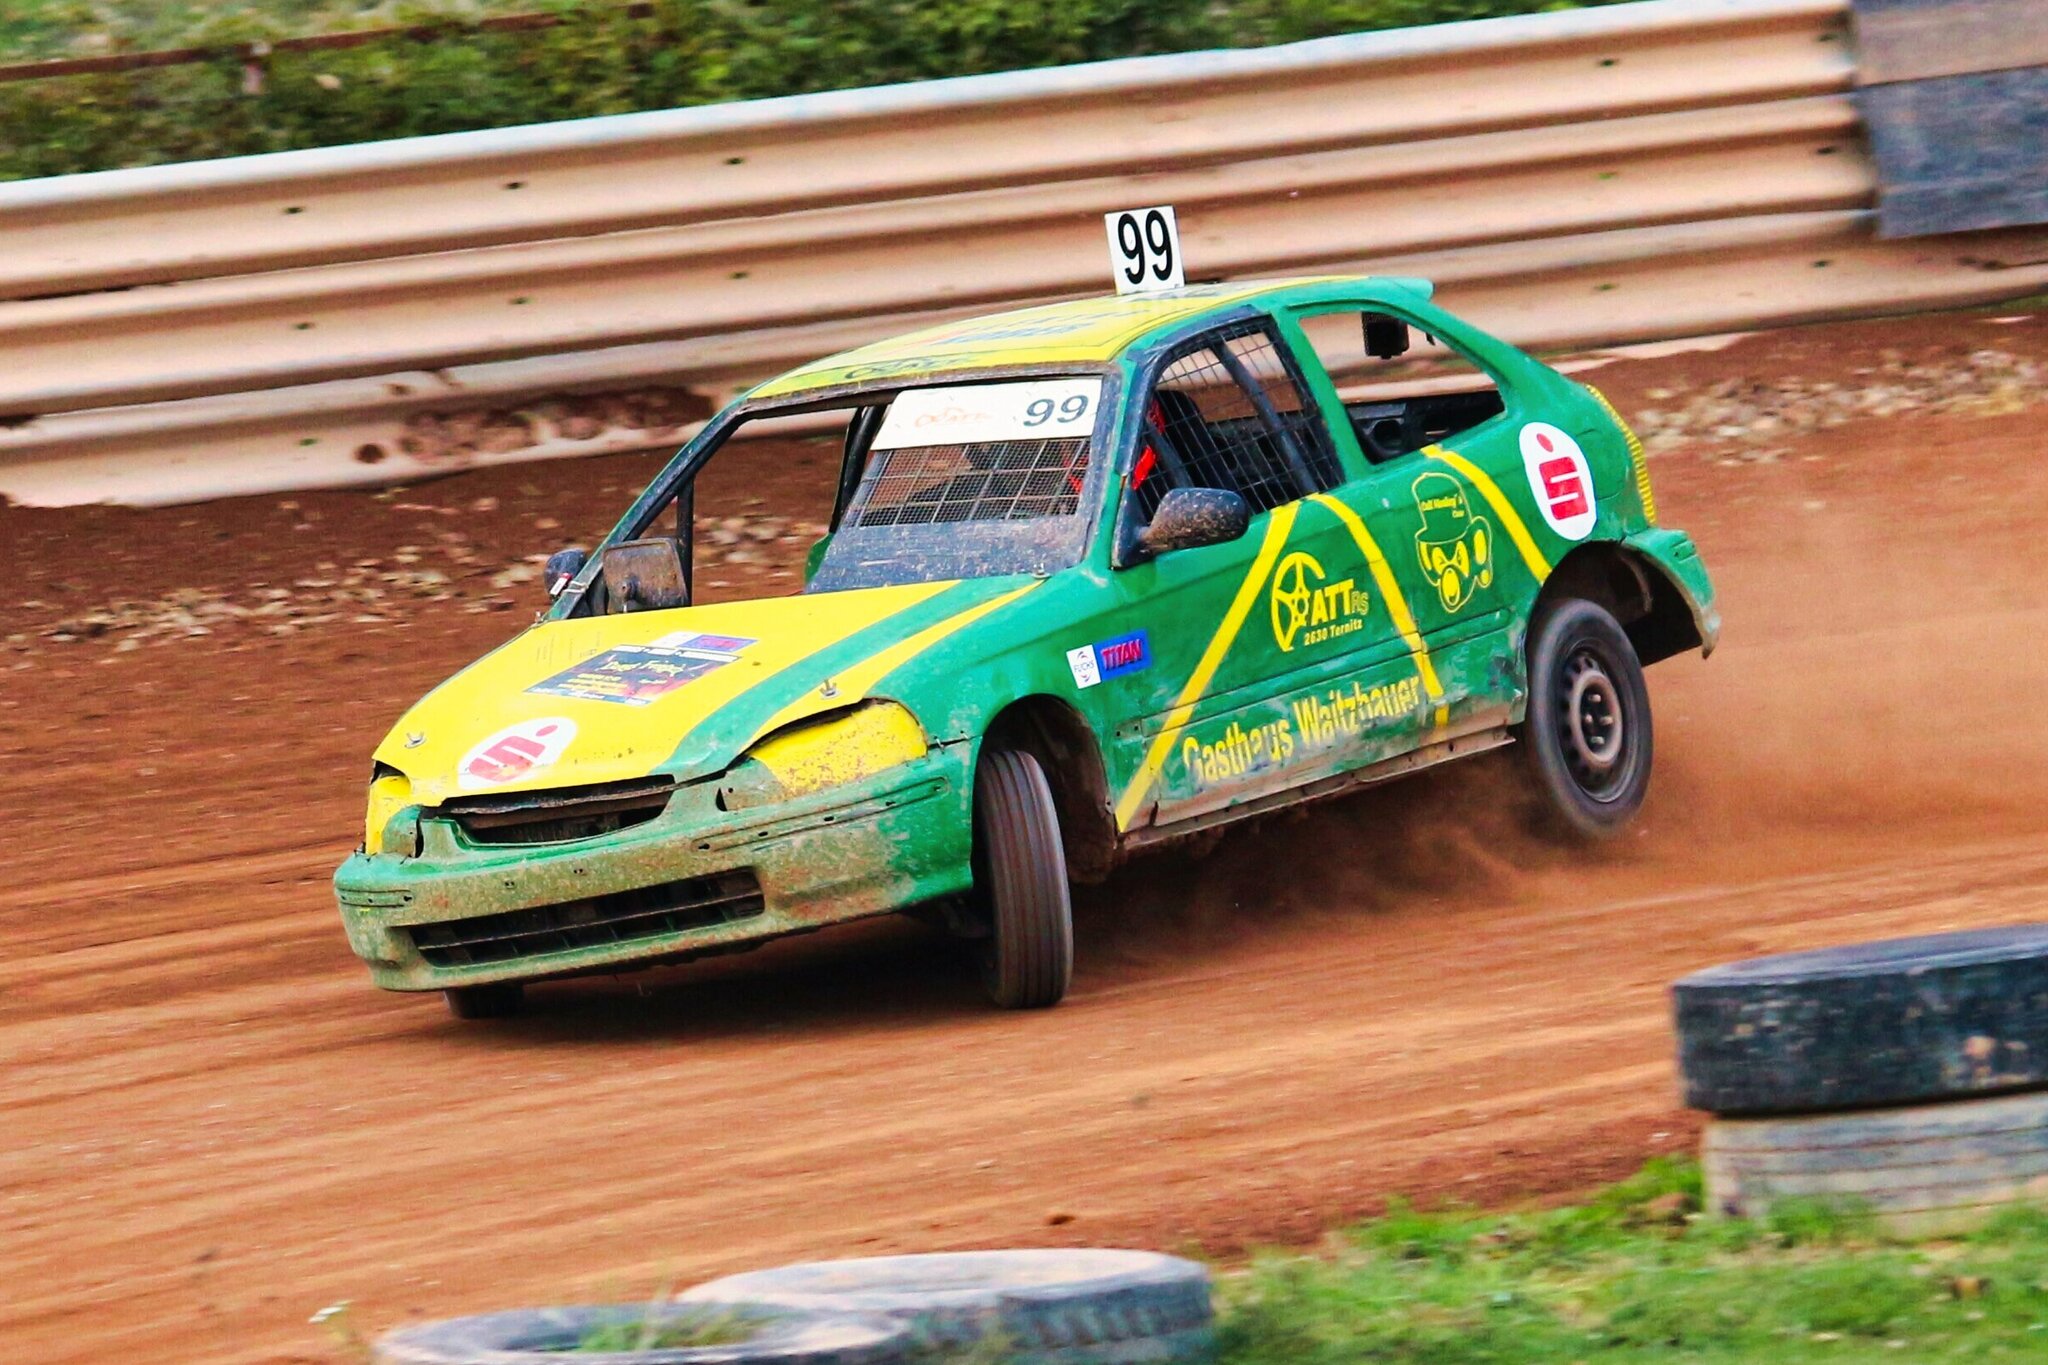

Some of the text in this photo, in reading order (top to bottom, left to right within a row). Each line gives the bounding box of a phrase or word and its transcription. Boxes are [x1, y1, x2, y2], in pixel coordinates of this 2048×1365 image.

[1117, 209, 1173, 285] 99
[1023, 395, 1089, 427] 99
[1304, 618, 1363, 646] 2630 Ternitz
[1101, 639, 1143, 670] TITAN
[1183, 718, 1294, 784] Gasthaus
